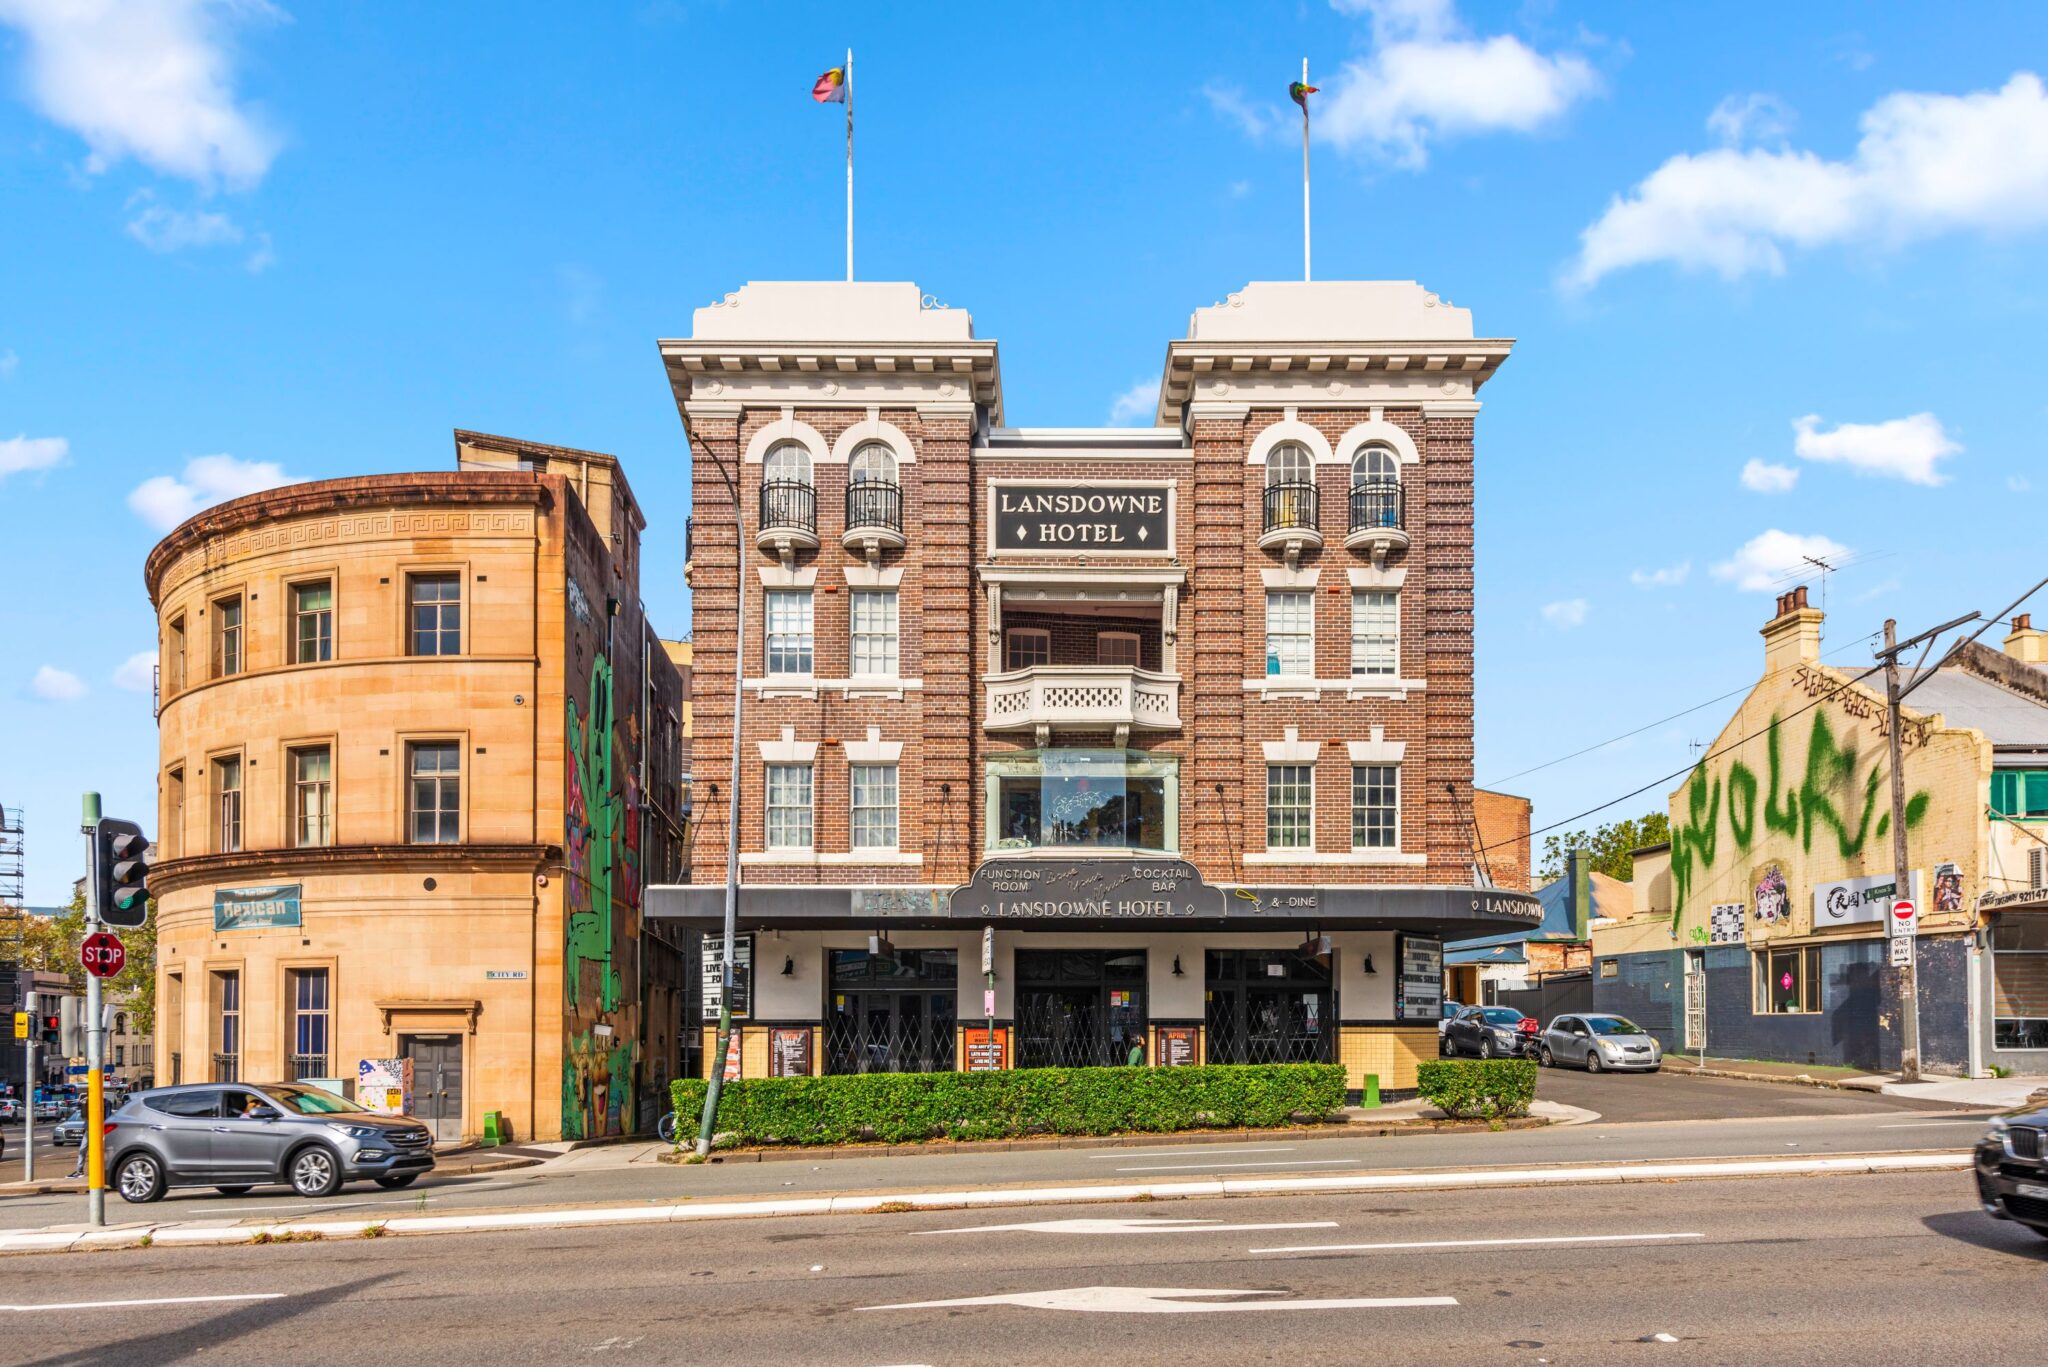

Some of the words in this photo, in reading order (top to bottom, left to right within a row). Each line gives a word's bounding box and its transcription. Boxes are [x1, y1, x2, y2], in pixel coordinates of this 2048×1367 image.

[1002, 494, 1162, 514] LANSDOWNE
[1039, 523, 1125, 543] HOTEL
[980, 868, 1041, 881] FUNCTION
[1134, 867, 1192, 880] COCKTAIL
[992, 881, 1029, 892] ROOM
[1152, 881, 1177, 893] BAR
[1271, 897, 1280, 908] &
[1288, 896, 1317, 908] DINE
[223, 900, 286, 918] Mexican
[999, 900, 1112, 917] LANSDOWNE
[1118, 901, 1176, 916] HOTEL
[85, 946, 122, 963] STOP
[1412, 953, 1431, 961] HOTEL
[706, 964, 720, 973] LIVE
[705, 1008, 718, 1016] THE
[1168, 1031, 1188, 1039] APRIL
